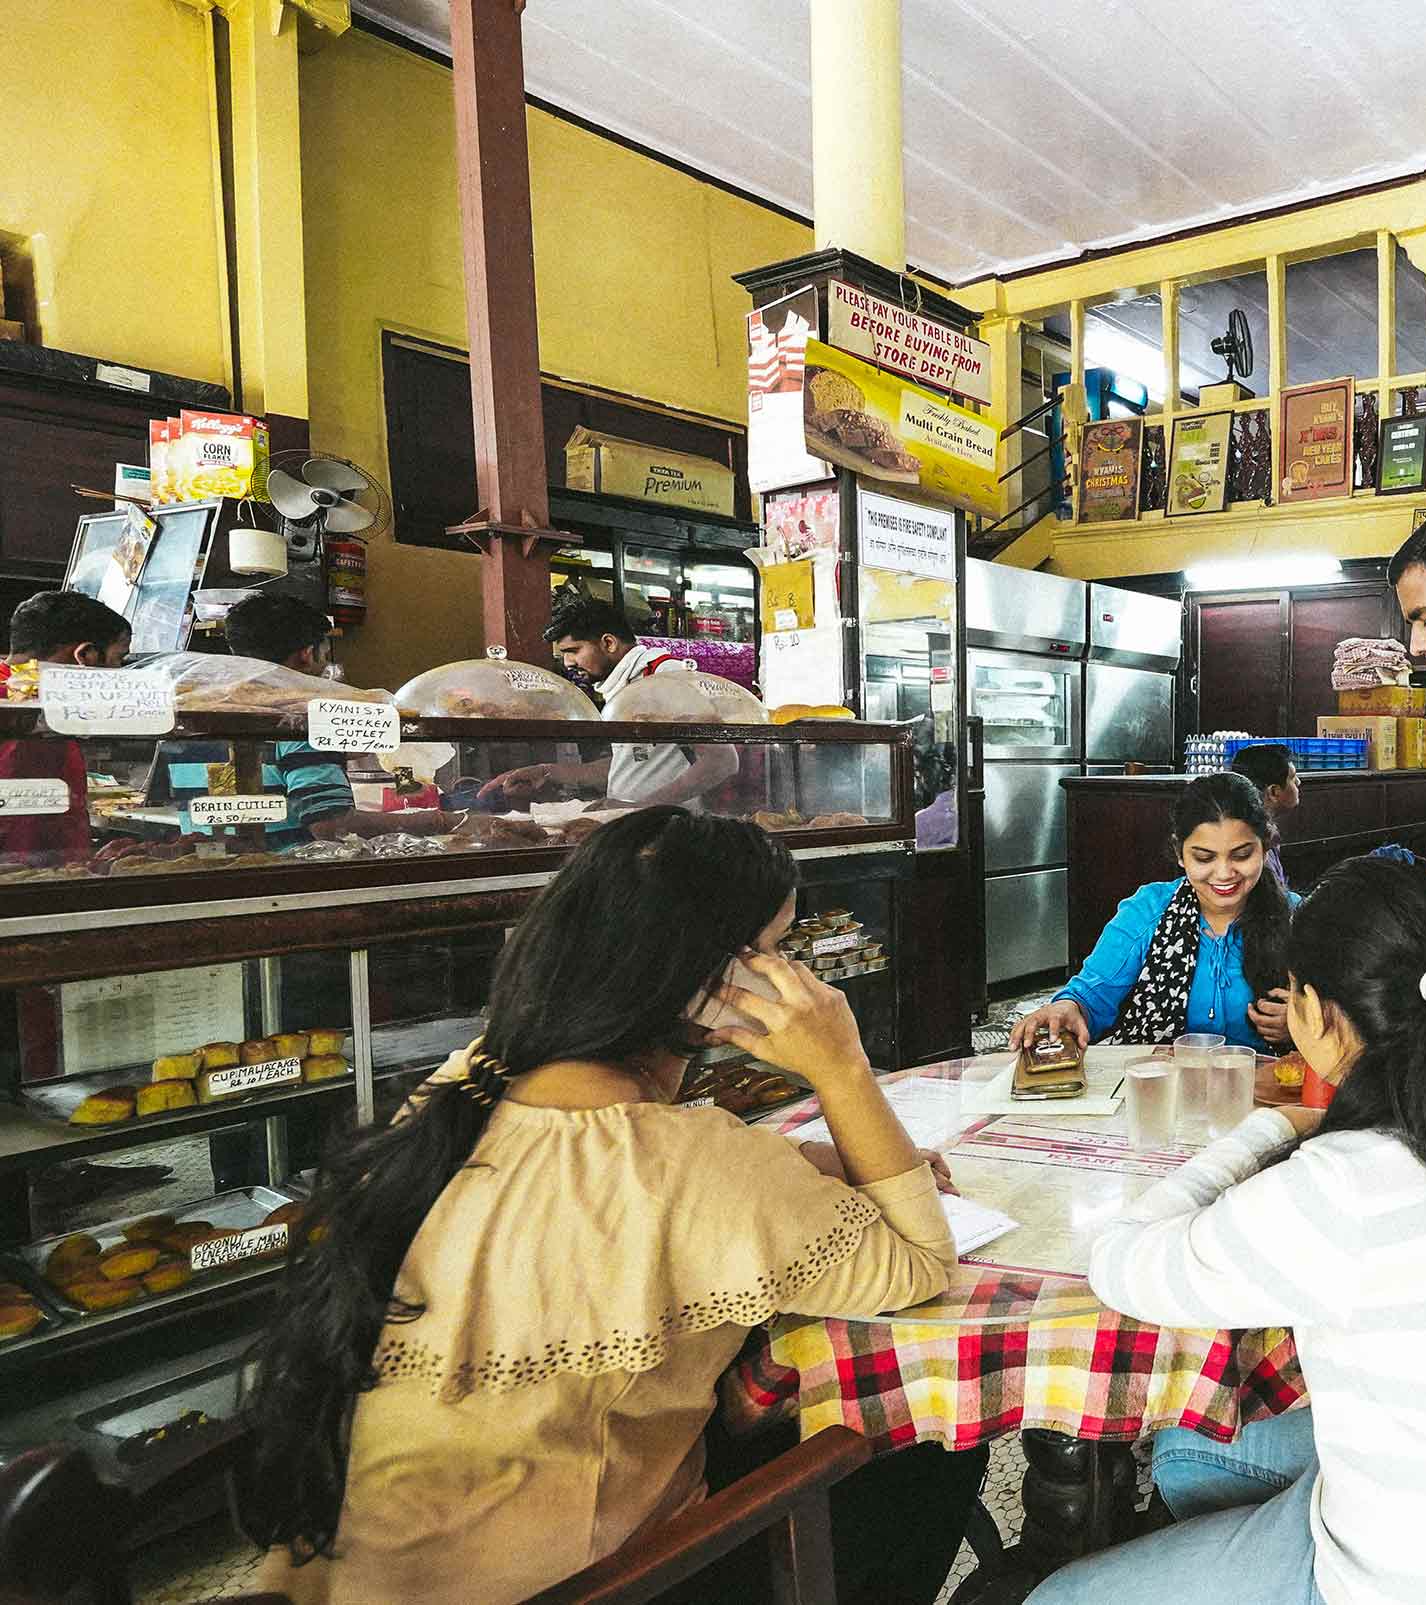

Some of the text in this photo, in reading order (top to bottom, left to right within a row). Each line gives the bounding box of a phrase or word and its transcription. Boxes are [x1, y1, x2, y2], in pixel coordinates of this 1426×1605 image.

[836, 286, 973, 354] PLEASE PAY YOUR TABLE BILL
[850, 312, 981, 375] BEFORE BUYING FROM
[875, 343, 952, 381] STORE DEPT
[905, 413, 993, 456] Multi Grain Bread
[203, 442, 231, 455] CORN
[1086, 475, 1128, 489] CHRISTMAS
[903, 518, 912, 534] FIRE
[912, 520, 926, 537] SAFETY
[104, 704, 136, 720] 15
[331, 717, 392, 728] CHICKEN
[335, 728, 386, 739] CUTLET
[237, 800, 284, 810] CUTLET
[266, 1067, 294, 1081] EACH
[1048, 1153, 1117, 1165] KYANI
[193, 1239, 254, 1263] PINEAPPLE
[194, 1232, 247, 1254] COCONUT
